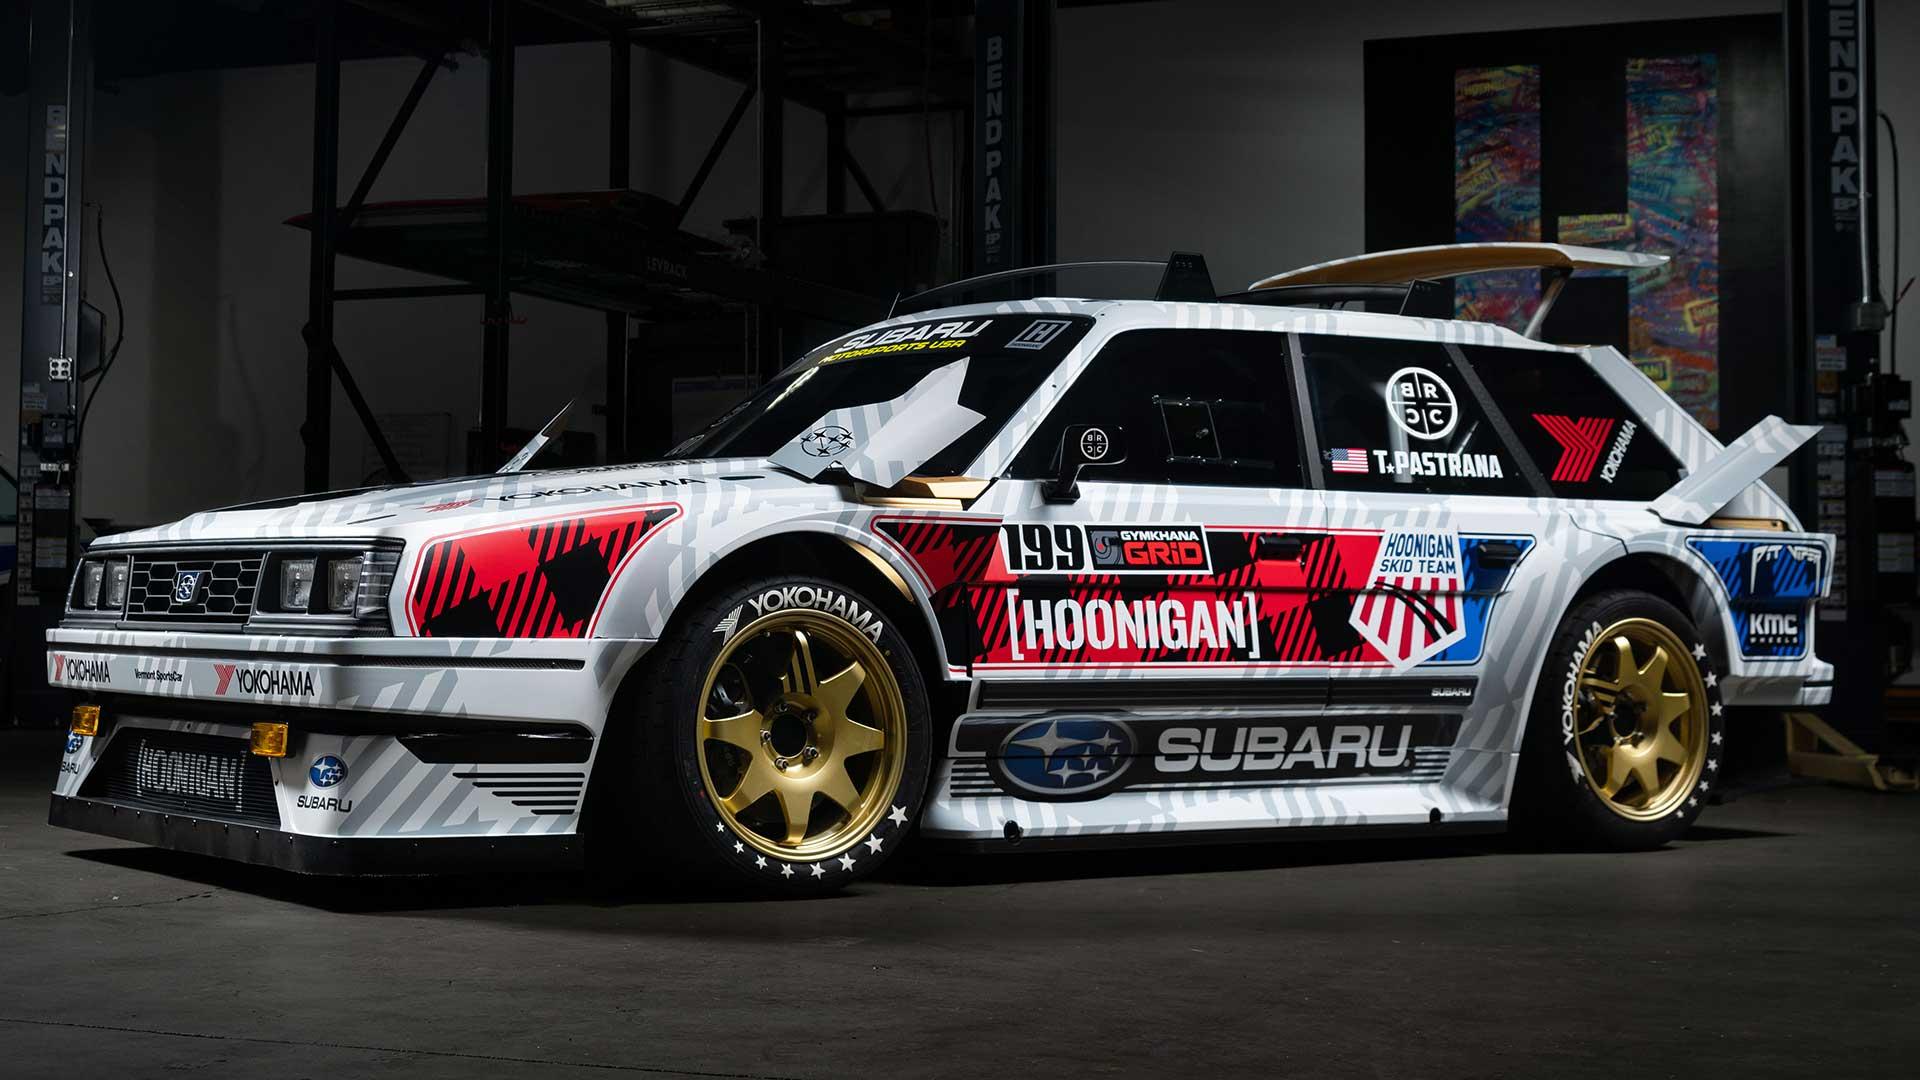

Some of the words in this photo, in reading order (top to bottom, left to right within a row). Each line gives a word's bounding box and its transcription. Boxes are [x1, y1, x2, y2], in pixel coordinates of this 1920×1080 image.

[984, 34, 1003, 232] BENDPAK
[41, 104, 66, 273] BENDPAK
[834, 319, 994, 353] SUBARU
[817, 341, 928, 365] MOTORSPORTS
[929, 339, 967, 350] USA
[1600, 419, 1638, 484] YOKOHAMA
[483, 477, 705, 502] YOKOHAMA
[1000, 523, 1086, 571] 199
[1119, 530, 1200, 542] GYMKHANA
[1384, 533, 1455, 559] HOONIGAN
[1379, 559, 1413, 573] SKID
[1418, 560, 1457, 575] TEAM
[748, 586, 884, 644] YOKOHAMA
[1750, 613, 1798, 635] KMC
[65, 659, 111, 684] YOKOHAMA
[236, 668, 315, 697] YOKOHAMA
[1562, 620, 1604, 746] YOKOHAMA
[1431, 687, 1472, 697] SUBARU
[1155, 725, 1413, 773] SUBARU
[297, 795, 353, 813] SUBARU
